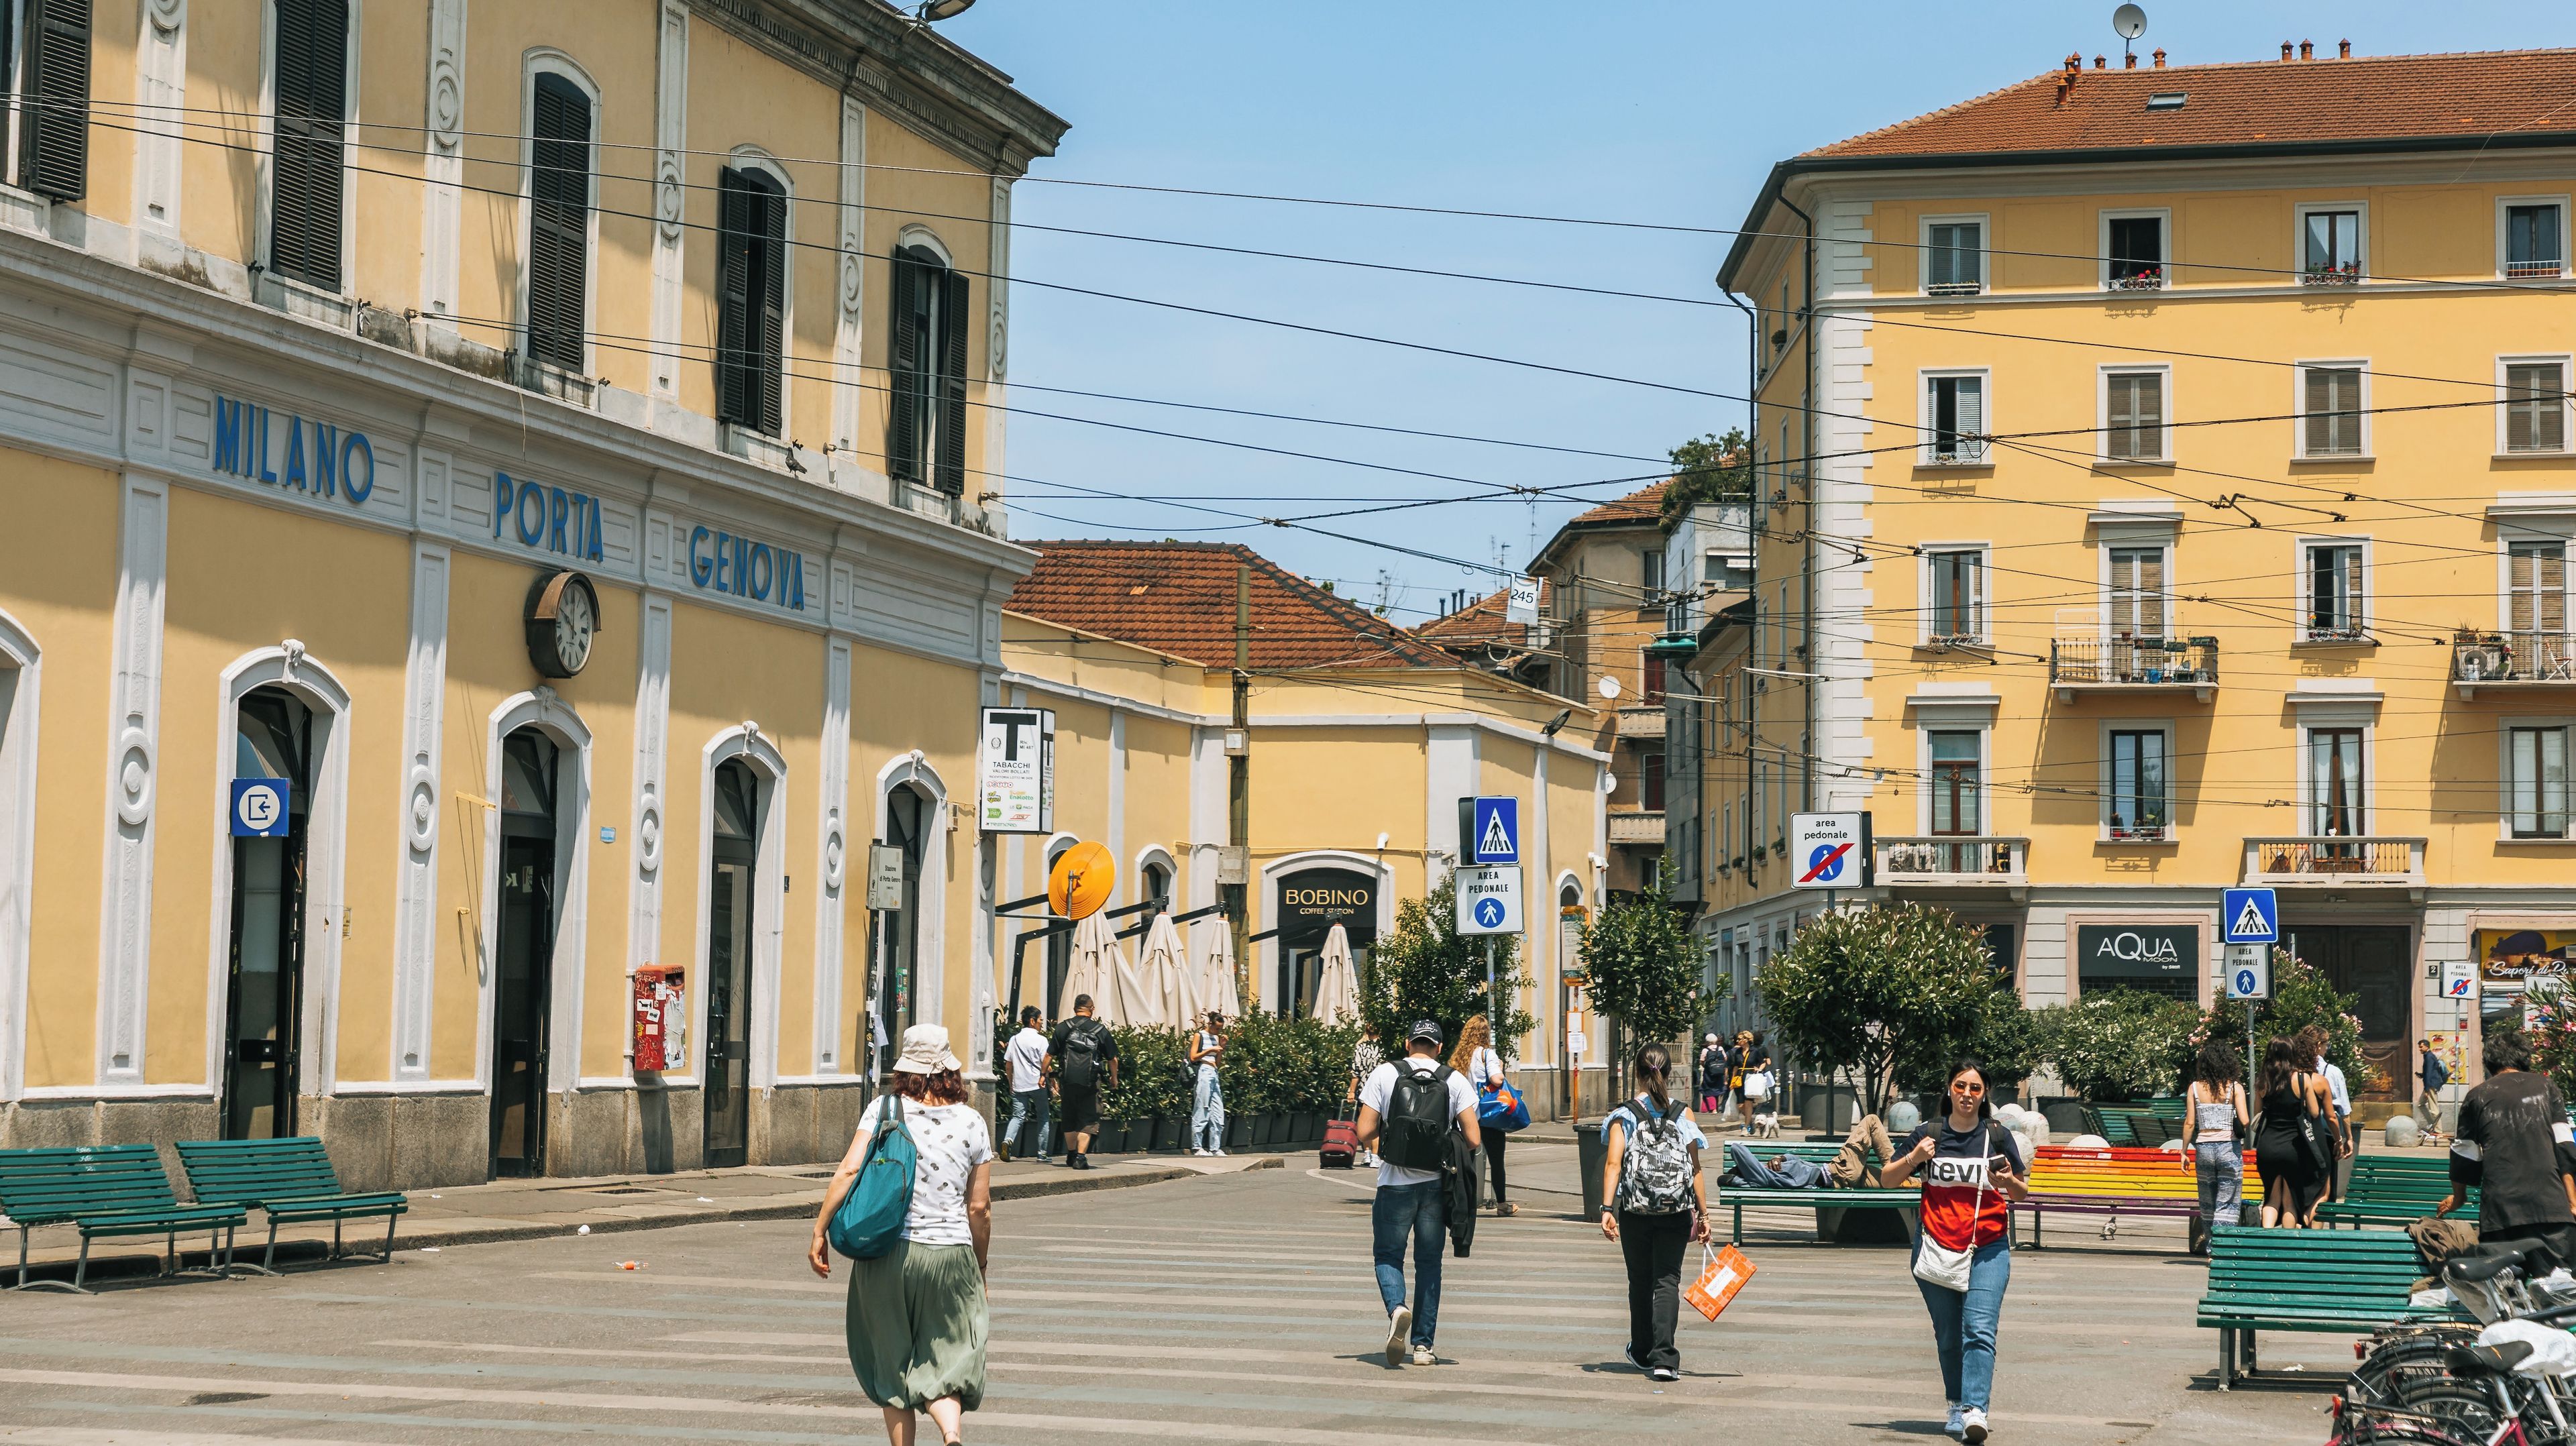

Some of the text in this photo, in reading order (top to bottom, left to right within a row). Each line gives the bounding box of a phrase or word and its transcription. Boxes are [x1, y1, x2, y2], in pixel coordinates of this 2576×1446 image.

[215, 397, 804, 610] MILANO PORTA GENOVA
[1511, 589, 1534, 604] 245
[989, 712, 1037, 761] T
[1805, 830, 1848, 840] pedonale
[1478, 871, 1499, 880] AREA
[1468, 884, 1509, 893] PEDONALE
[1285, 889, 1368, 905] BOBINO
[2097, 932, 2178, 961] AQUA
[2489, 960, 2536, 978] Sapori
[2537, 965, 2551, 975] di
